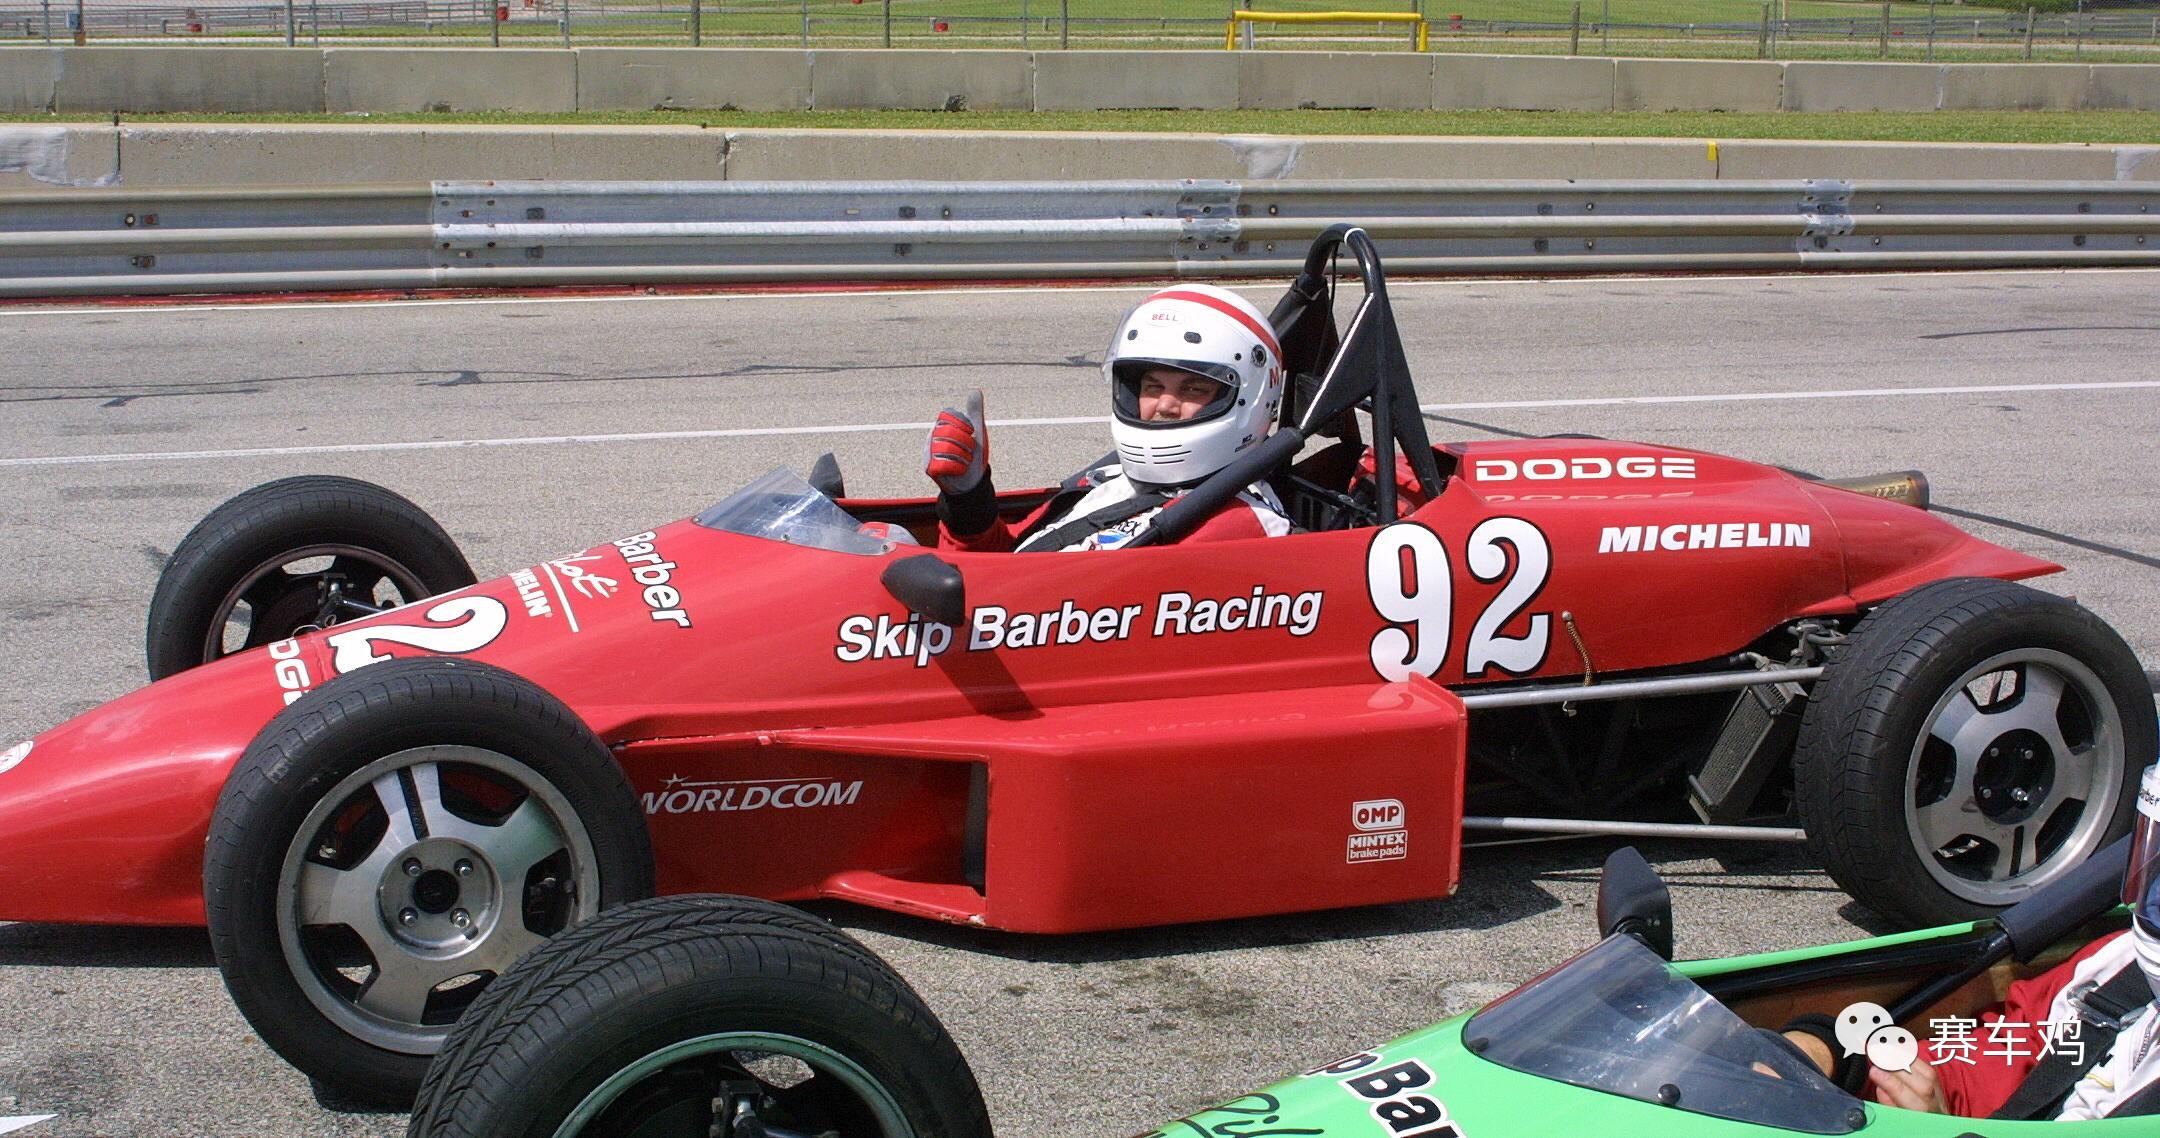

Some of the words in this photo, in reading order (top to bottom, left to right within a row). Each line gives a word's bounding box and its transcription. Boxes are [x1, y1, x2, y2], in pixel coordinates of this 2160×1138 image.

[1151, 313, 1179, 322] BELL
[1475, 456, 1697, 482] DODGE
[1598, 522, 1811, 554] MICHELIN
[612, 530, 693, 629] Barber
[1367, 515, 1553, 683] 92
[835, 609, 953, 667] Skip
[967, 599, 1142, 653] Barber
[1153, 584, 1325, 637] Racing
[1357, 805, 1400, 825] OMP
[1349, 832, 1405, 849] MINTEX
[1350, 847, 1380, 859] brake
[1380, 845, 1405, 859] pads
